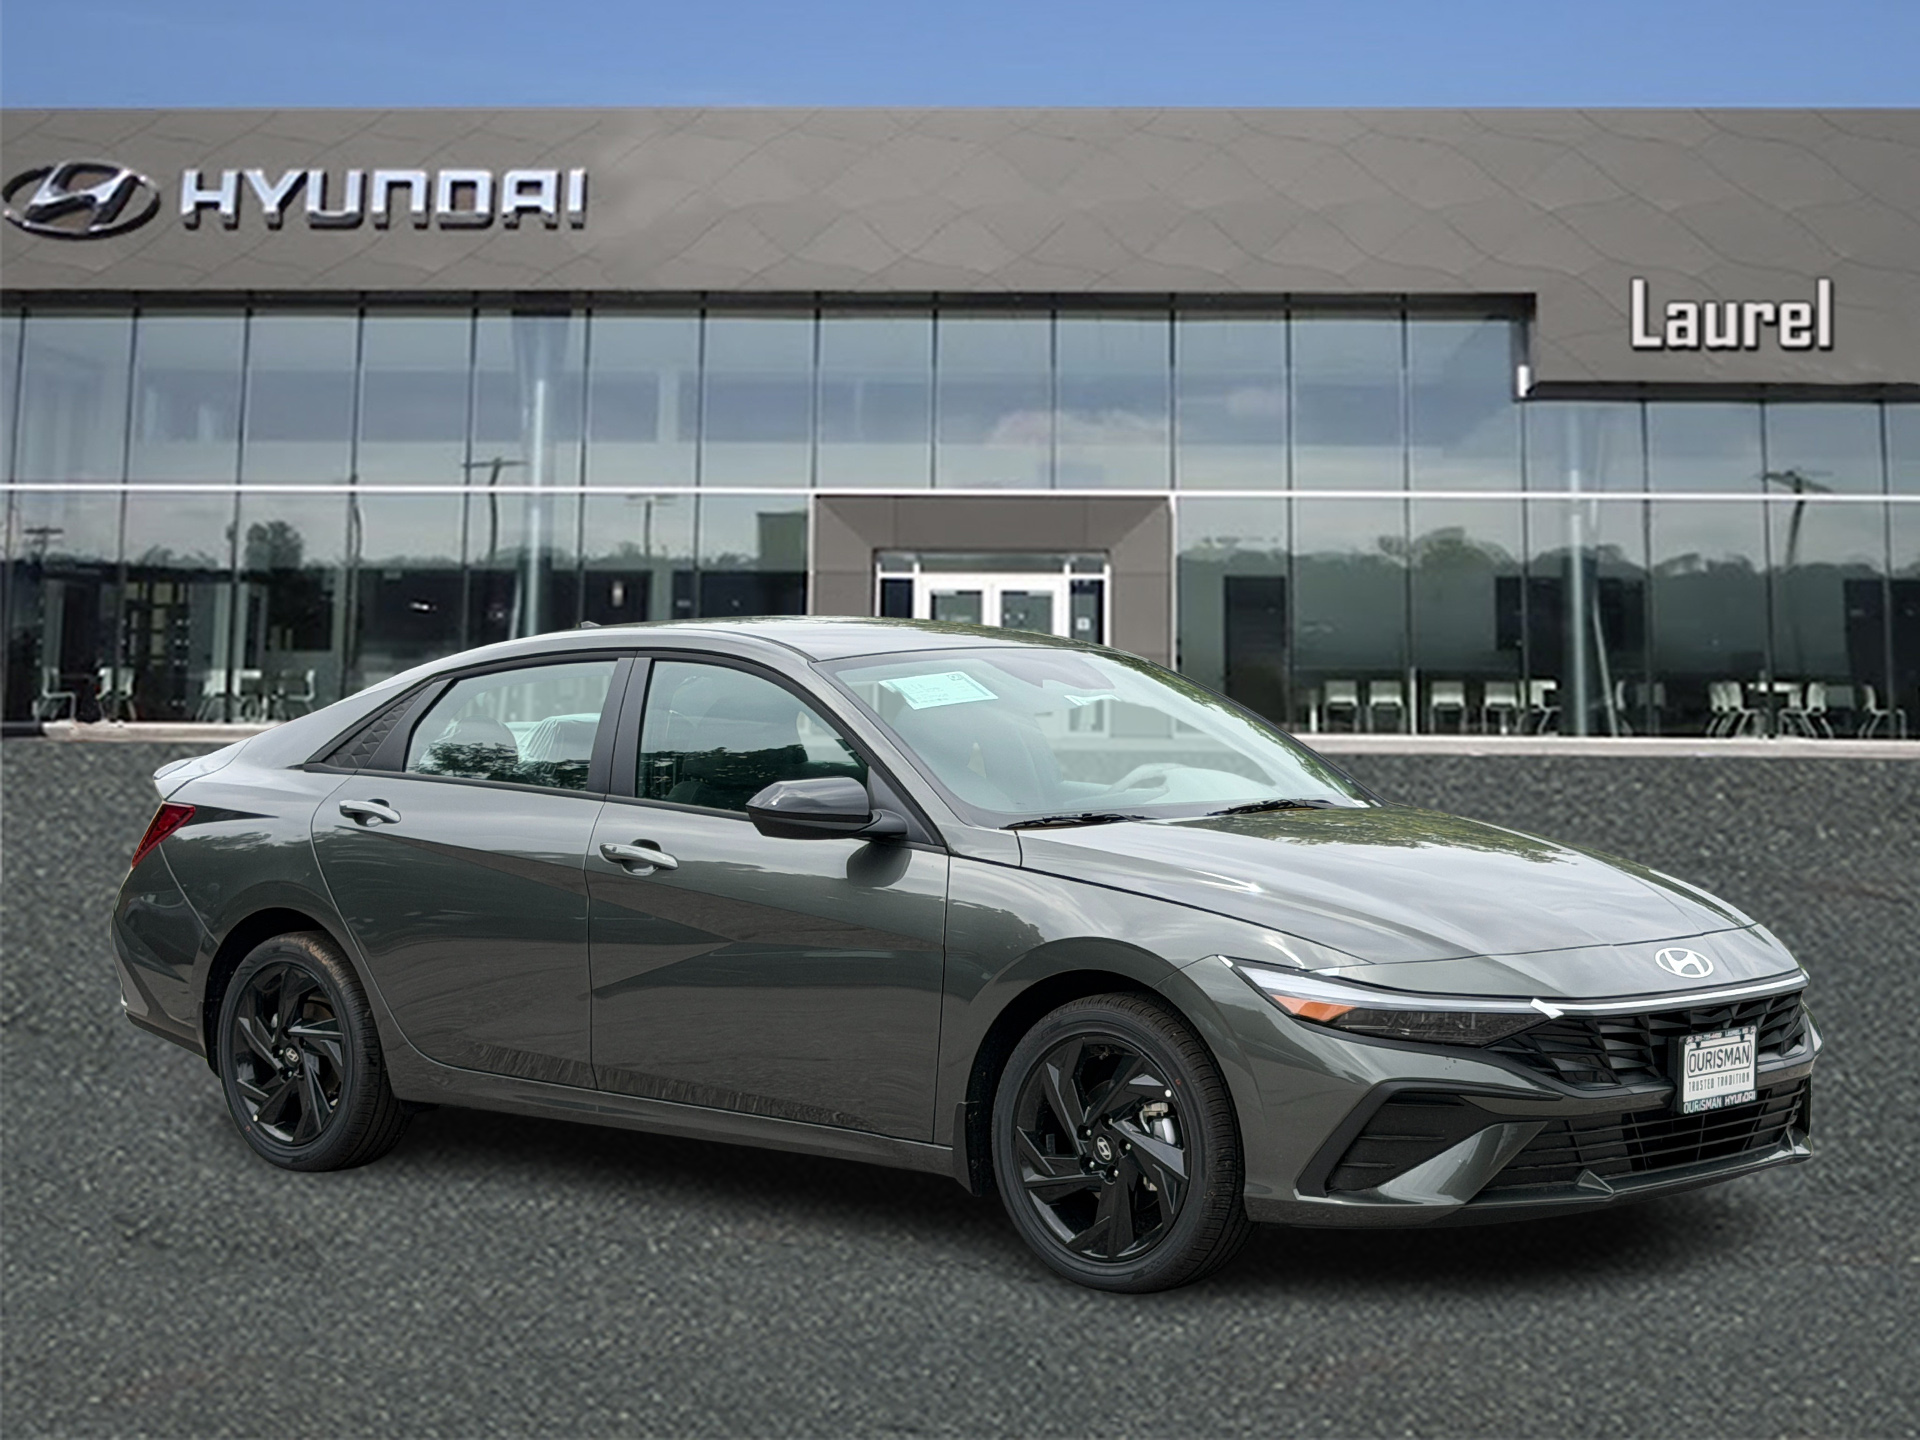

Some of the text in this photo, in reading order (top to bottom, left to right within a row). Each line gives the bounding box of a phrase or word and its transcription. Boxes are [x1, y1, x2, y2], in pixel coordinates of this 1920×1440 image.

[180, 167, 588, 230] HYUNDAI
[1630, 278, 1832, 348] Laurel
[1689, 1045, 1750, 1072] OURISMAN
[1688, 1072, 1750, 1092] TRUSTED TRADITION
[1683, 1090, 1756, 1114] OURISMAN HYUNDAI
